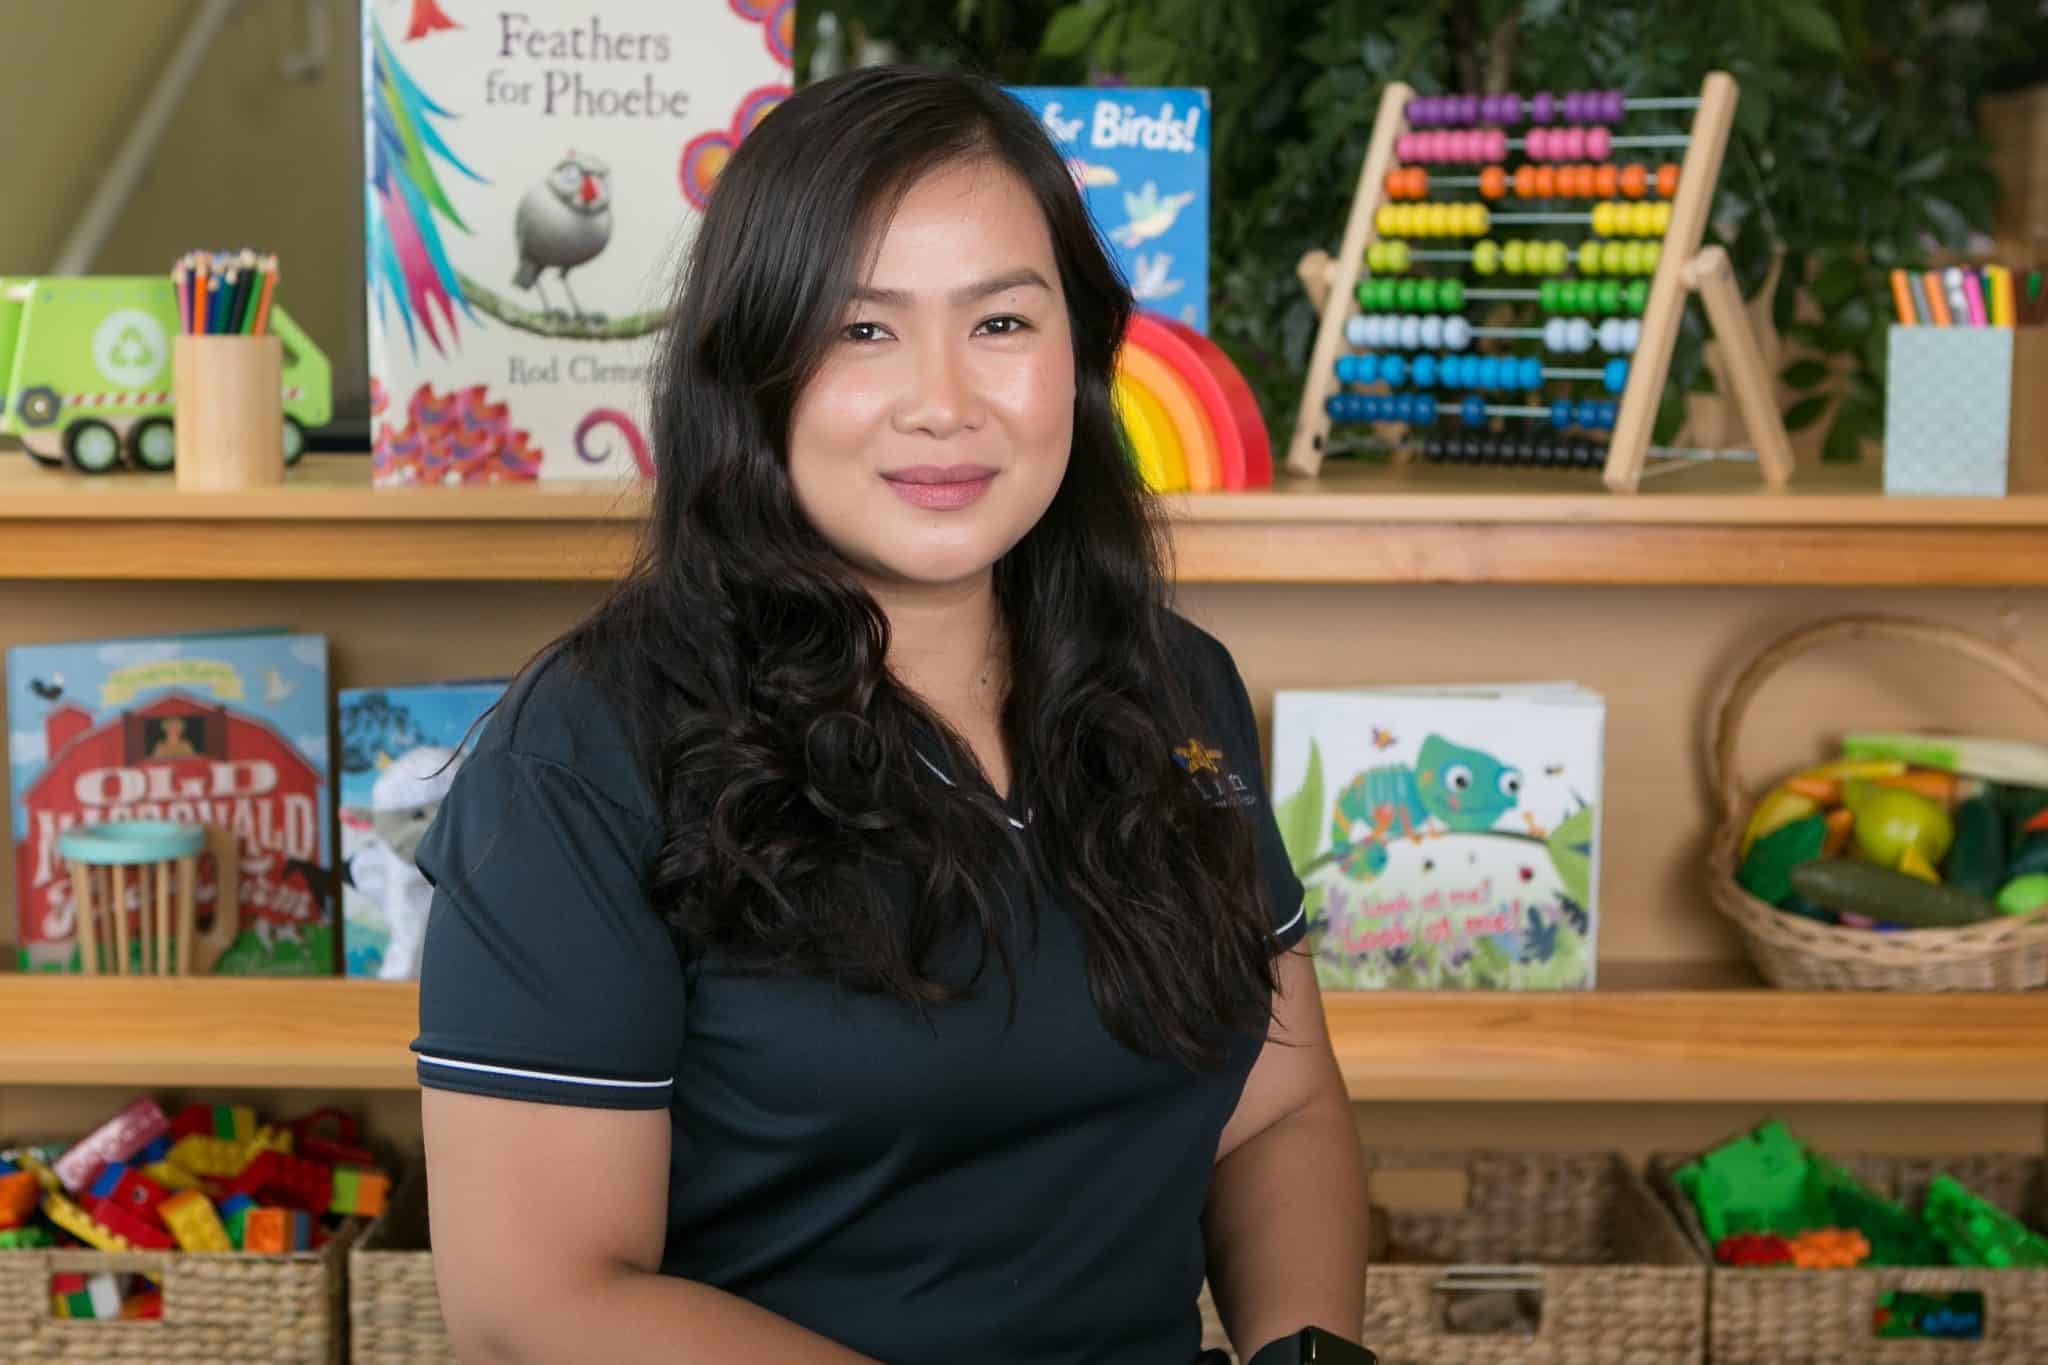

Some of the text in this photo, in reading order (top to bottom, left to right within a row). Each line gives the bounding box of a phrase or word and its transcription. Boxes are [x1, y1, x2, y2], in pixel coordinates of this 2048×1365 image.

[498, 12, 671, 62] Feathers
[485, 69, 690, 117] for Phoebe
[1092, 100, 1200, 153] Birds!
[74, 760, 277, 806] OLD
